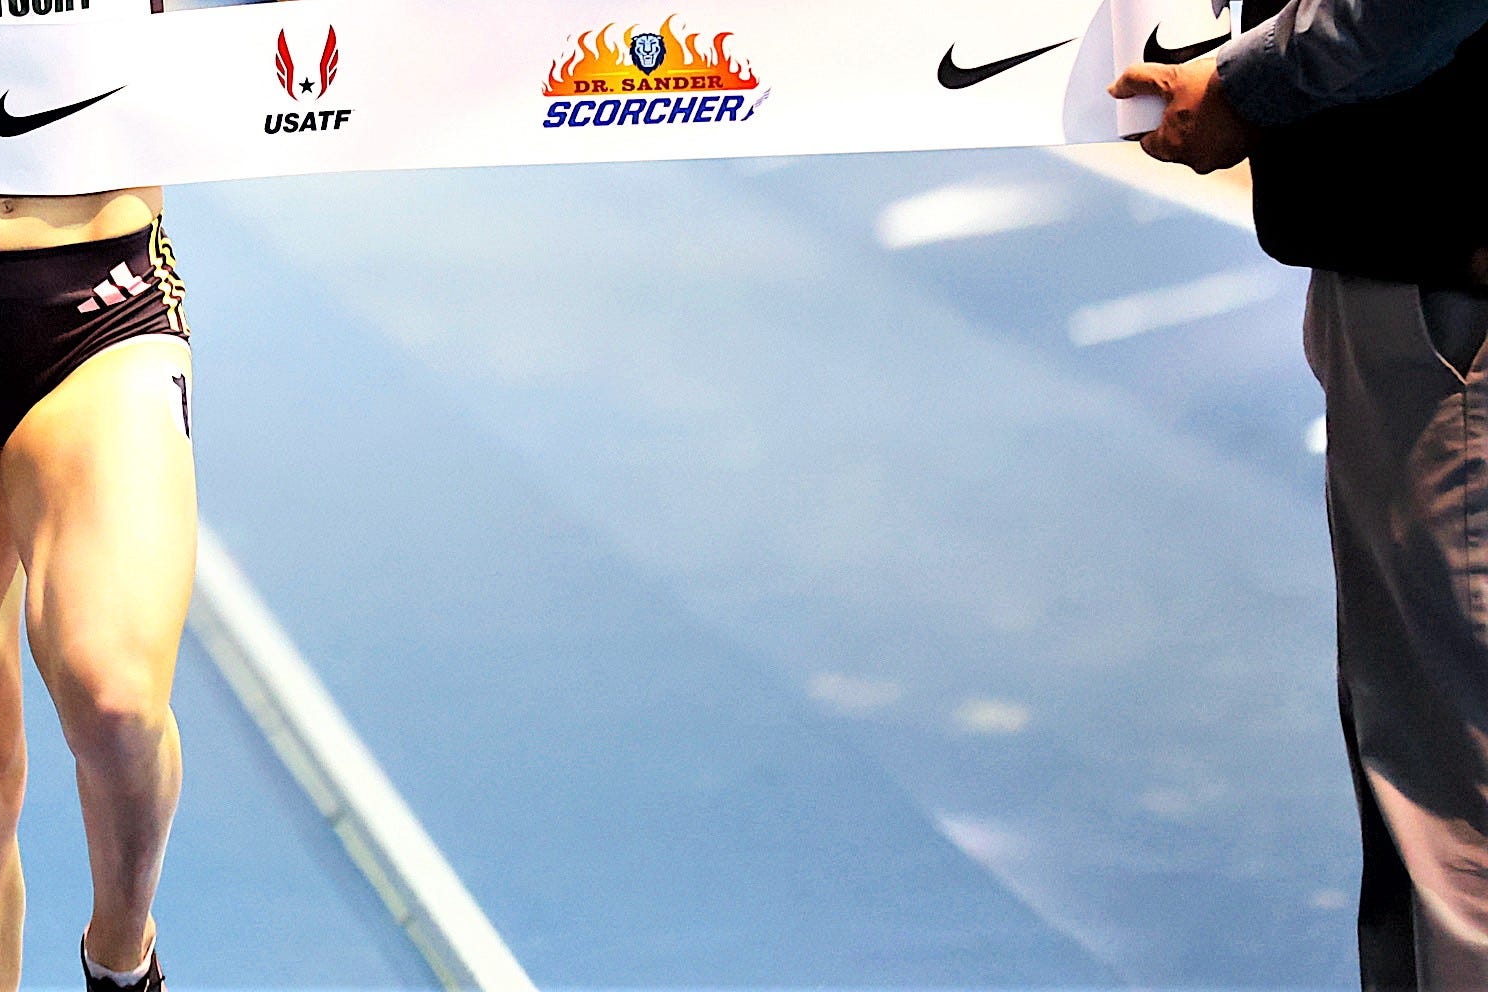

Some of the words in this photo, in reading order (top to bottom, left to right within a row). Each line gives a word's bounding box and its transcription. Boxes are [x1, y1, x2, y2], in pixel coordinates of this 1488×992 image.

[574, 78, 614, 94] DR.
[621, 75, 724, 91] SANDER
[264, 109, 352, 134] USATF
[542, 95, 745, 128] SCORCHER
